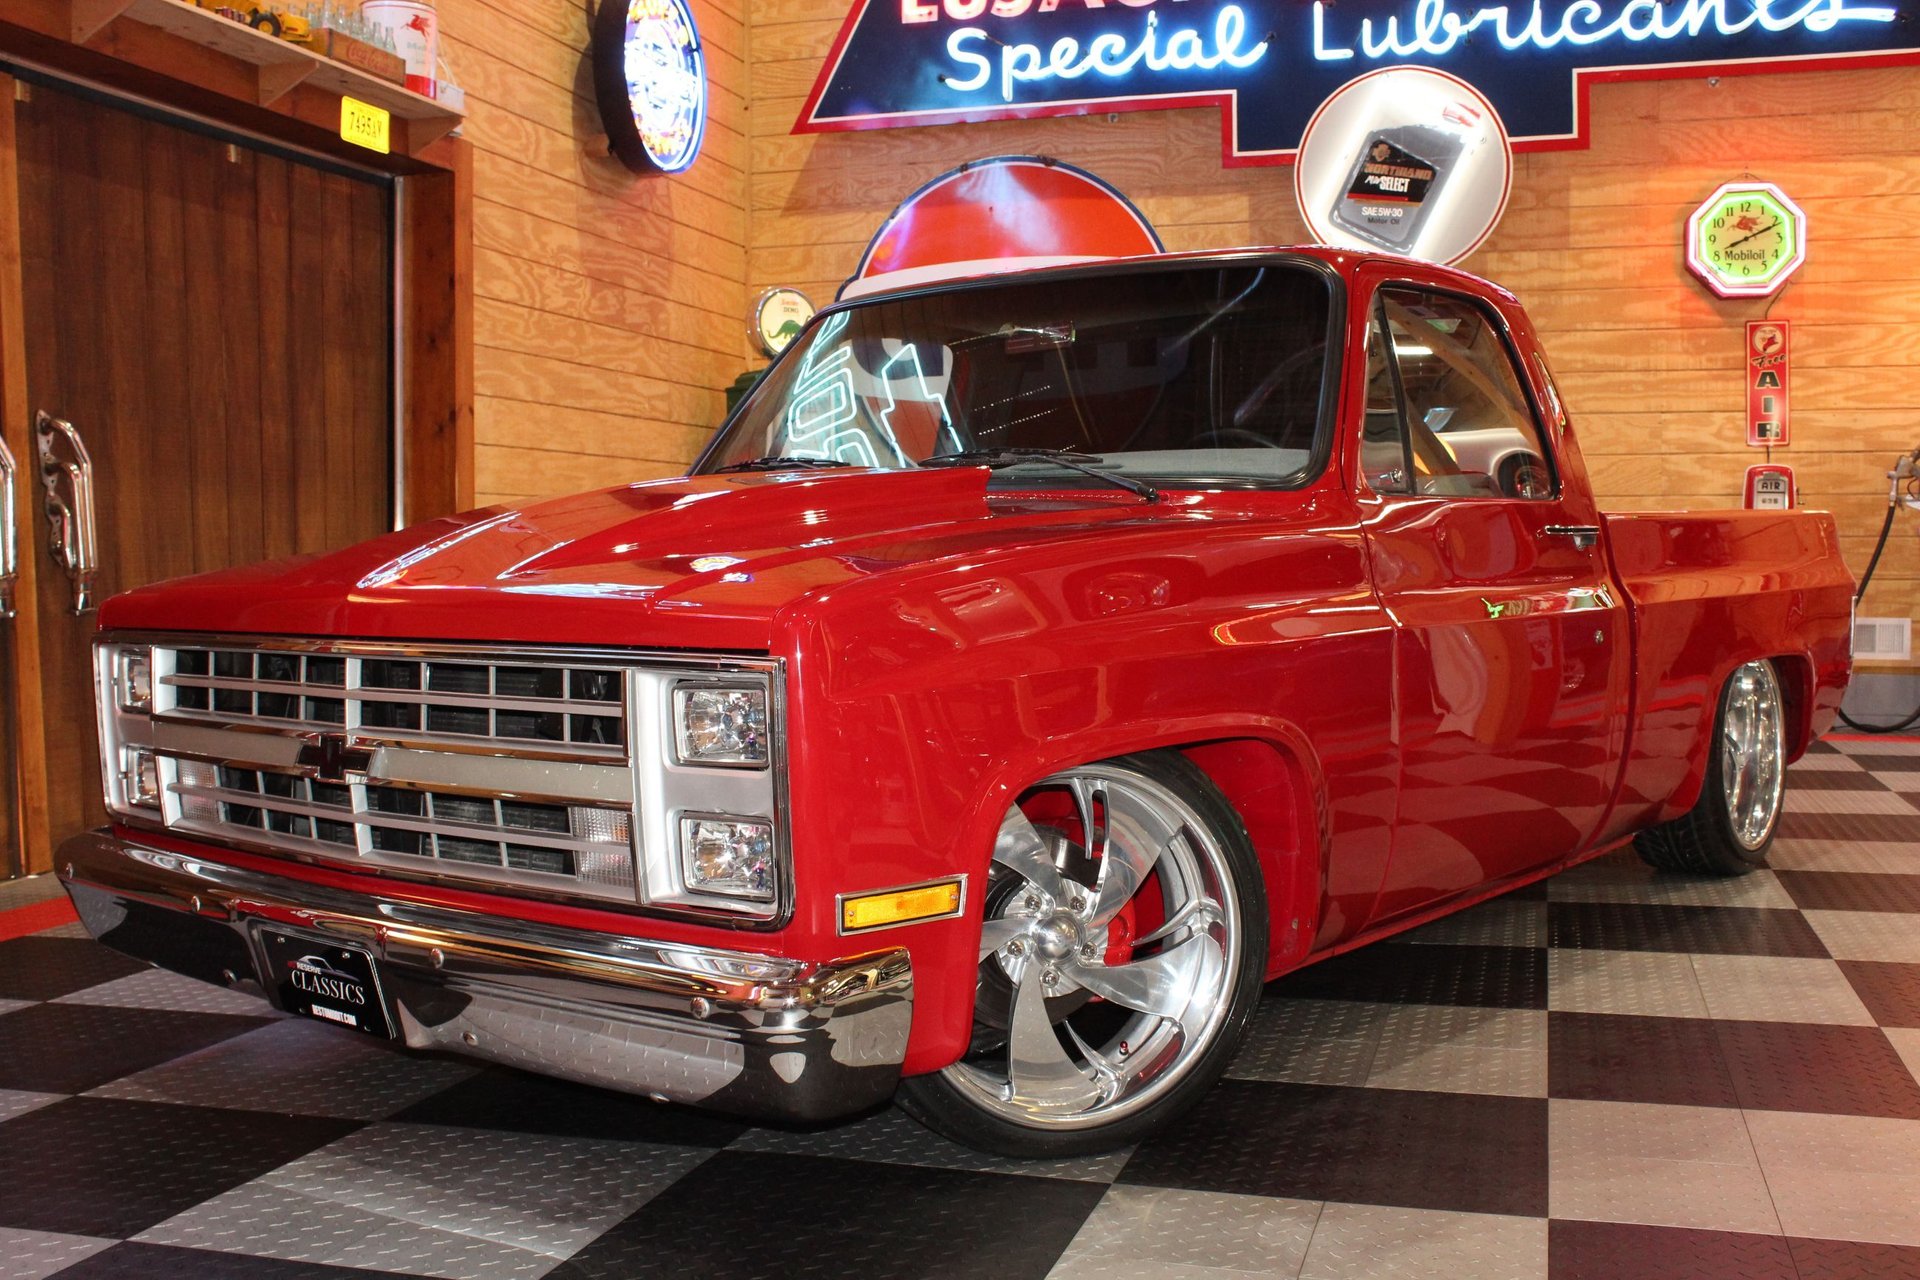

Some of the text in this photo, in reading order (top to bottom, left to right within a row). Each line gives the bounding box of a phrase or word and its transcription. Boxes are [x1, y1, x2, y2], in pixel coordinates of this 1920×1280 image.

[944, 5, 1268, 101] Special
[1379, 175, 1410, 193] SELECT
[1361, 206, 1403, 217] SAE 5W-30
[1726, 207, 1734, 217] 11
[1741, 202, 1751, 213] 12
[1761, 205, 1765, 215] 1
[1713, 217, 1725, 228] 10
[1709, 234, 1717, 245] 9
[1776, 232, 1783, 244] 3
[1713, 251, 1721, 262] 8
[1724, 249, 1765, 260] Mobiloil
[1771, 248, 1779, 259] 4
[1726, 262, 1732, 272] 7
[1742, 265, 1750, 276] 6
[1760, 260, 1768, 272] 5
[1751, 354, 1786, 368] Free
[1755, 370, 1781, 439] AIR
[1761, 481, 1781, 490] AIR
[291, 969, 365, 1005] CLASSICS
